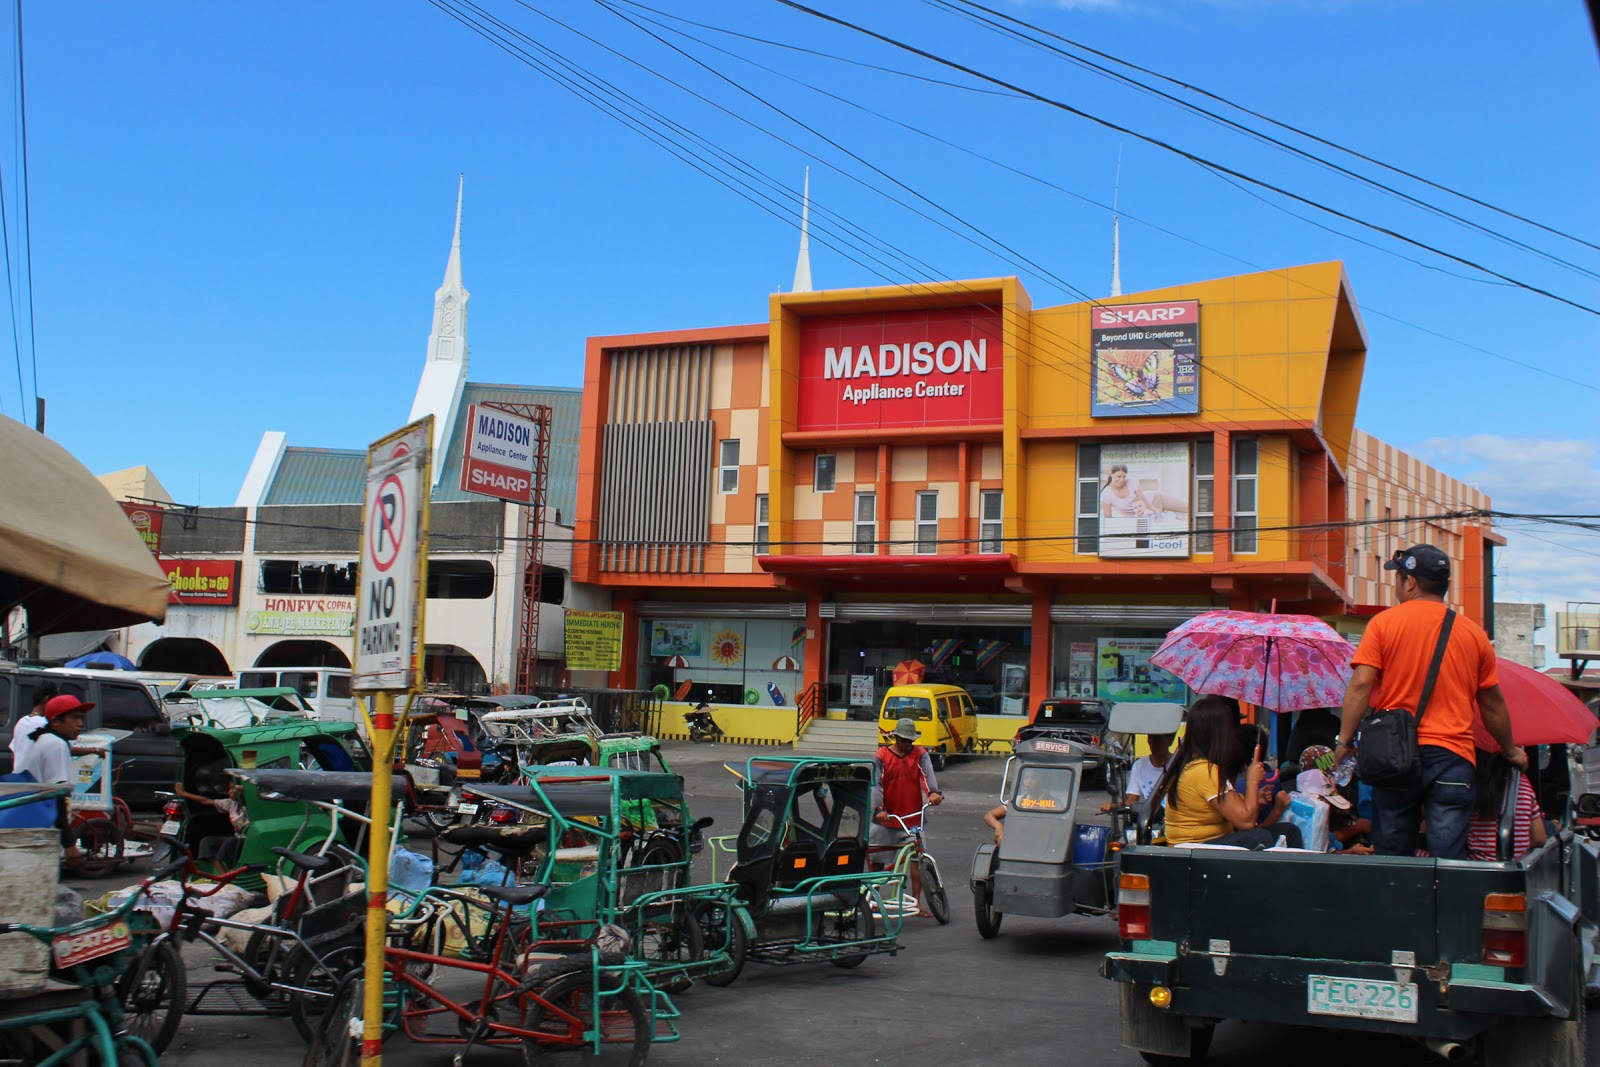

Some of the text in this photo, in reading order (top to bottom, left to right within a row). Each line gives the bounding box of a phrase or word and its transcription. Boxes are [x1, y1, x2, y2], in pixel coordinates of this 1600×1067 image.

[1100, 307, 1186, 324] SHARP
[1101, 330, 1185, 342] Beyond UHD Experience
[824, 339, 987, 379] MADISON
[842, 381, 965, 405] Appliance Center
[479, 415, 530, 446] MADISON
[477, 442, 528, 461] Appliance Center
[1103, 450, 1187, 460] Intelligent Cooling Solution
[471, 468, 528, 492] SHARP
[1151, 540, 1182, 549] i-cool
[168, 567, 229, 591] Chooks to GO
[326, 600, 352, 611] COPRA
[369, 576, 395, 620] NO
[298, 617, 348, 631] MARKETING
[566, 619, 620, 629] IMMEDIATE HIRING
[360, 621, 400, 656] PARKING
[1035, 742, 1068, 752] SERVICE
[1313, 980, 1412, 1009] FEC 226
